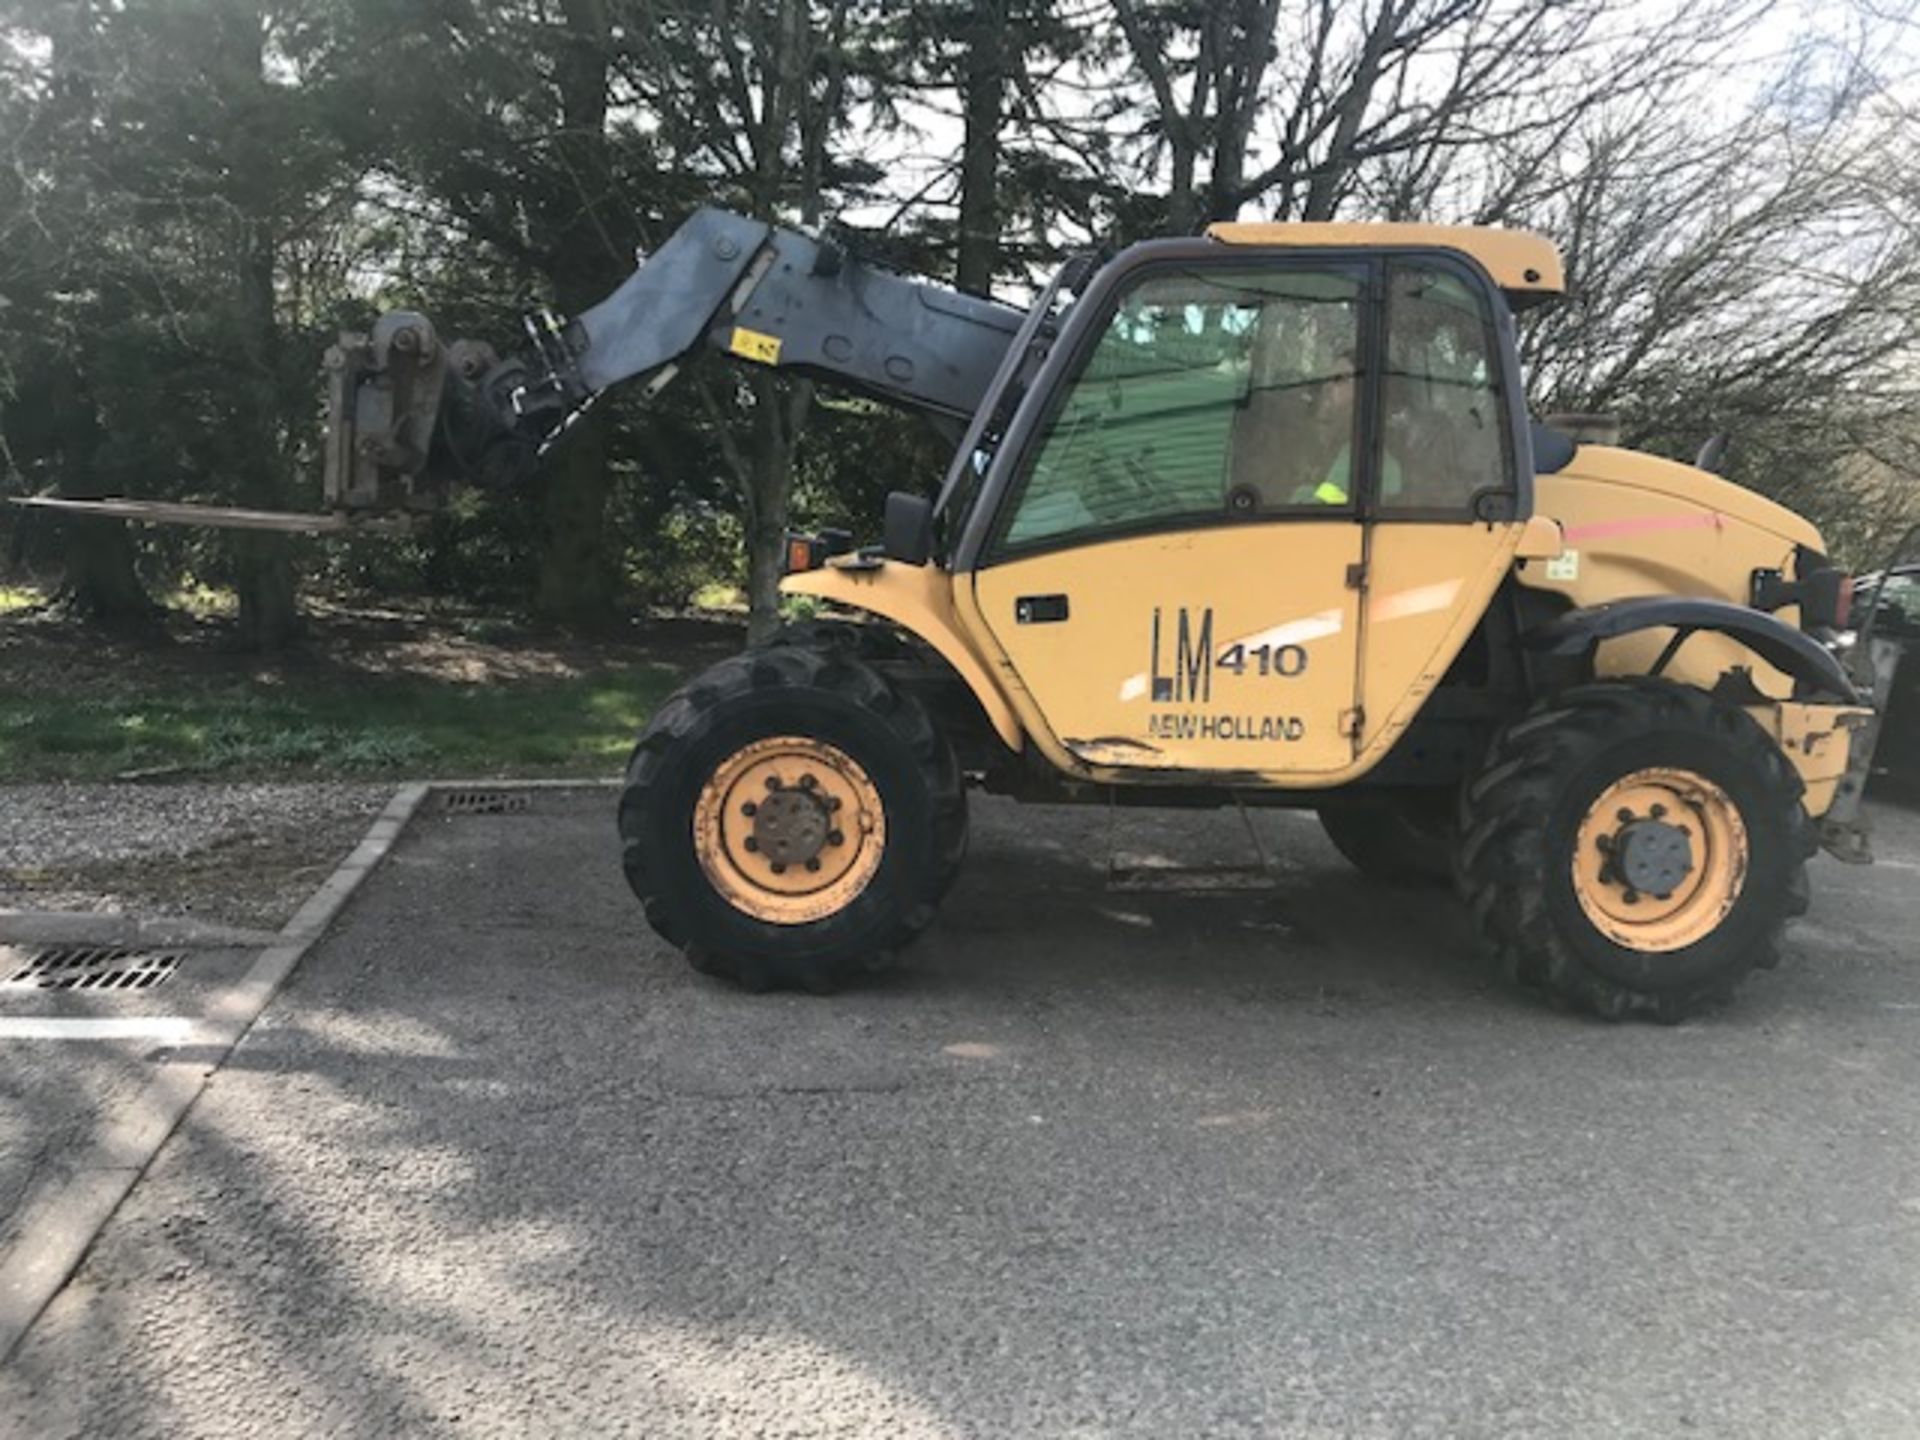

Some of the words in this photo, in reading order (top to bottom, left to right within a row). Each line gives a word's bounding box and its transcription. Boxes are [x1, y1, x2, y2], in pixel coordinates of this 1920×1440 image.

[1151, 607, 1213, 702] LM
[1216, 643, 1308, 676] 410
[1201, 715, 1304, 741] HOLLAND
